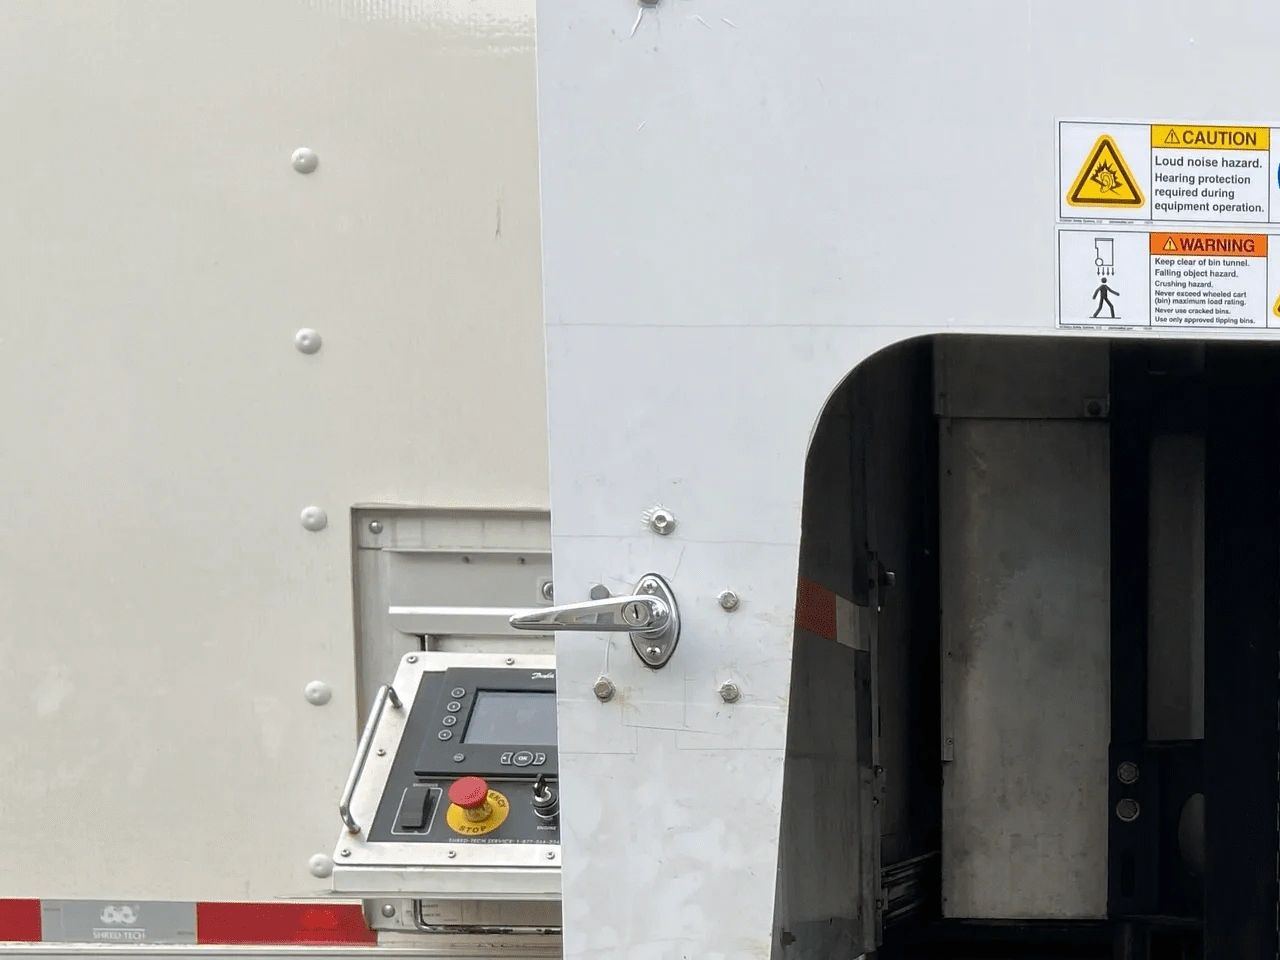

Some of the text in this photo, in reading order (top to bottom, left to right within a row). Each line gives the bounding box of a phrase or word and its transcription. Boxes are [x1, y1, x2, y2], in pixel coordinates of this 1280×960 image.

[1182, 130, 1257, 146] CAUTION
[1155, 155, 1263, 168] Loud noise hazard.
[1155, 173, 1251, 185] Hearing protection
[1155, 187, 1235, 200] required during
[1155, 201, 1264, 213] equipment operation.
[1180, 238, 1255, 252] WARNING
[1155, 258, 1175, 267] Keep
[1177, 258, 1196, 266] clear
[1223, 259, 1250, 267] tunnel.
[1155, 269, 1238, 278] Falling object hazard.
[1155, 280, 1187, 288] Crushing
[1155, 297, 1171, 305] (bin)
[459, 825, 487, 833] STOP
